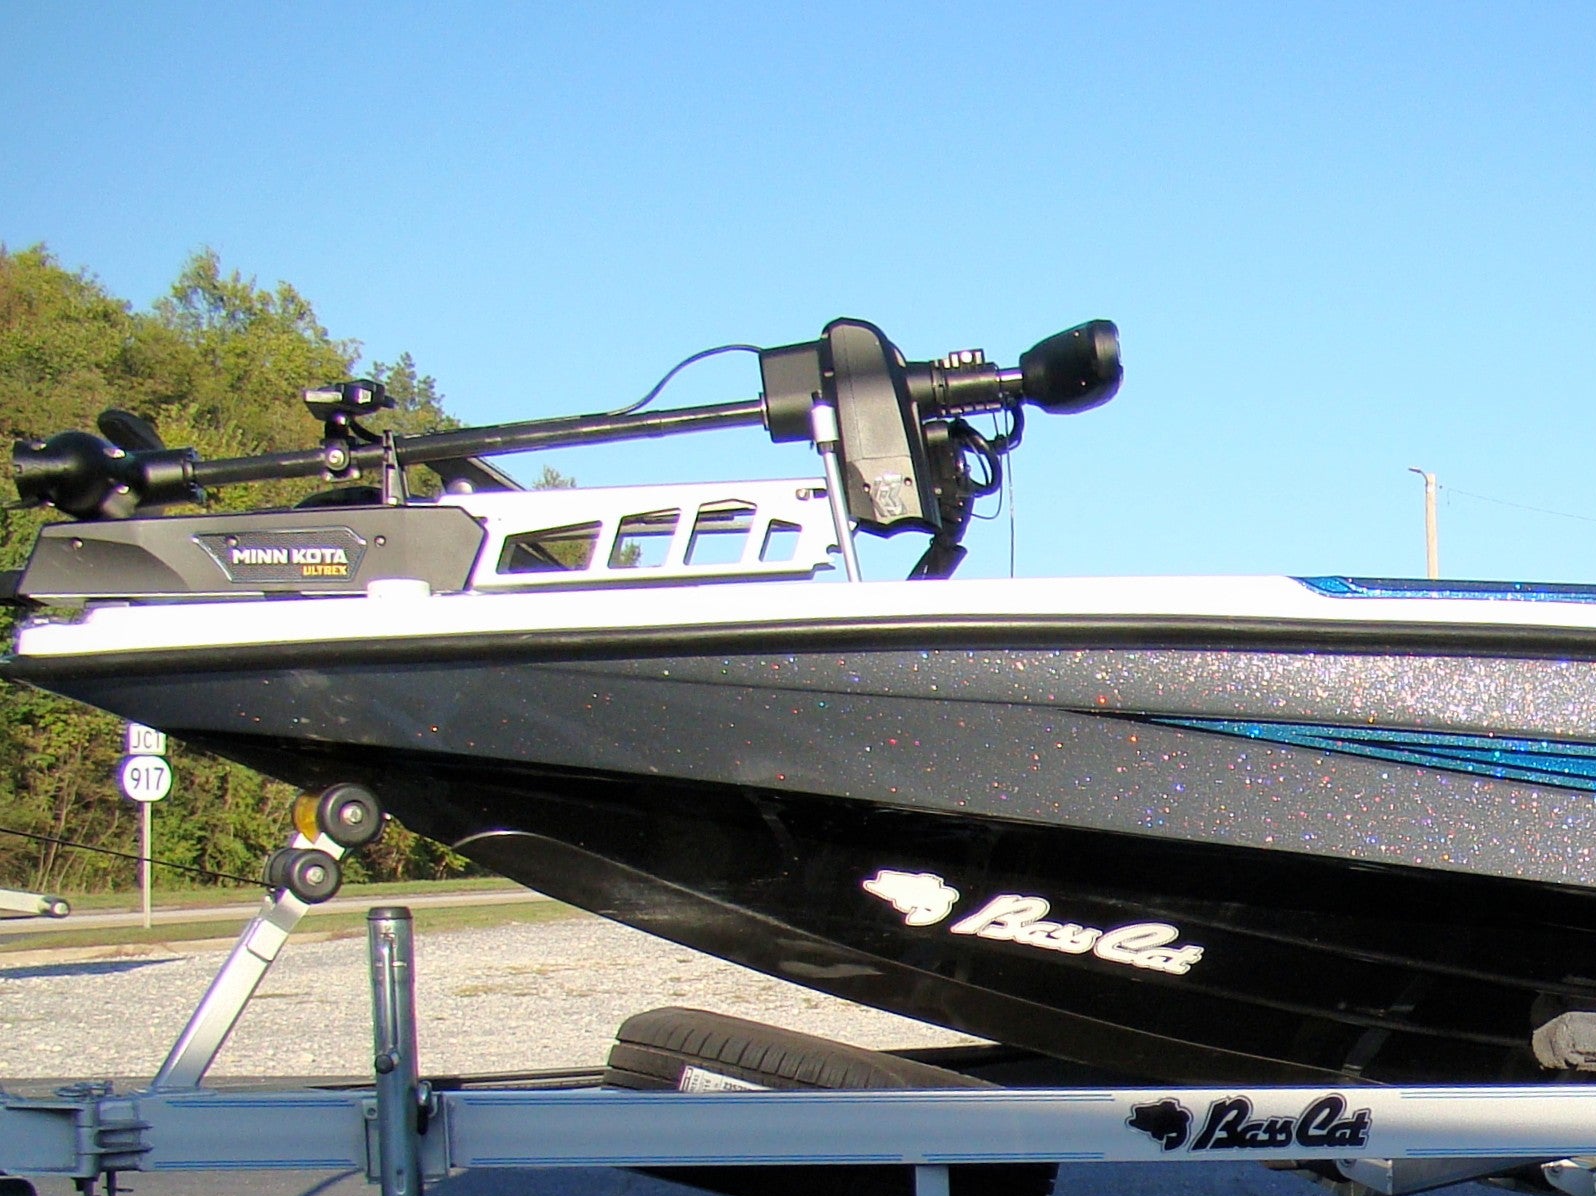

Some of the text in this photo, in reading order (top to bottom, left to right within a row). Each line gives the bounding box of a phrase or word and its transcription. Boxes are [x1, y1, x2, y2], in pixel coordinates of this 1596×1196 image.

[232, 547, 349, 564] MINN KOTA
[303, 565, 348, 576] ULTREX
[130, 767, 165, 791] 917
[950, 894, 1205, 975] Bass Cat
[1191, 1093, 1371, 1151] Bass Cat
